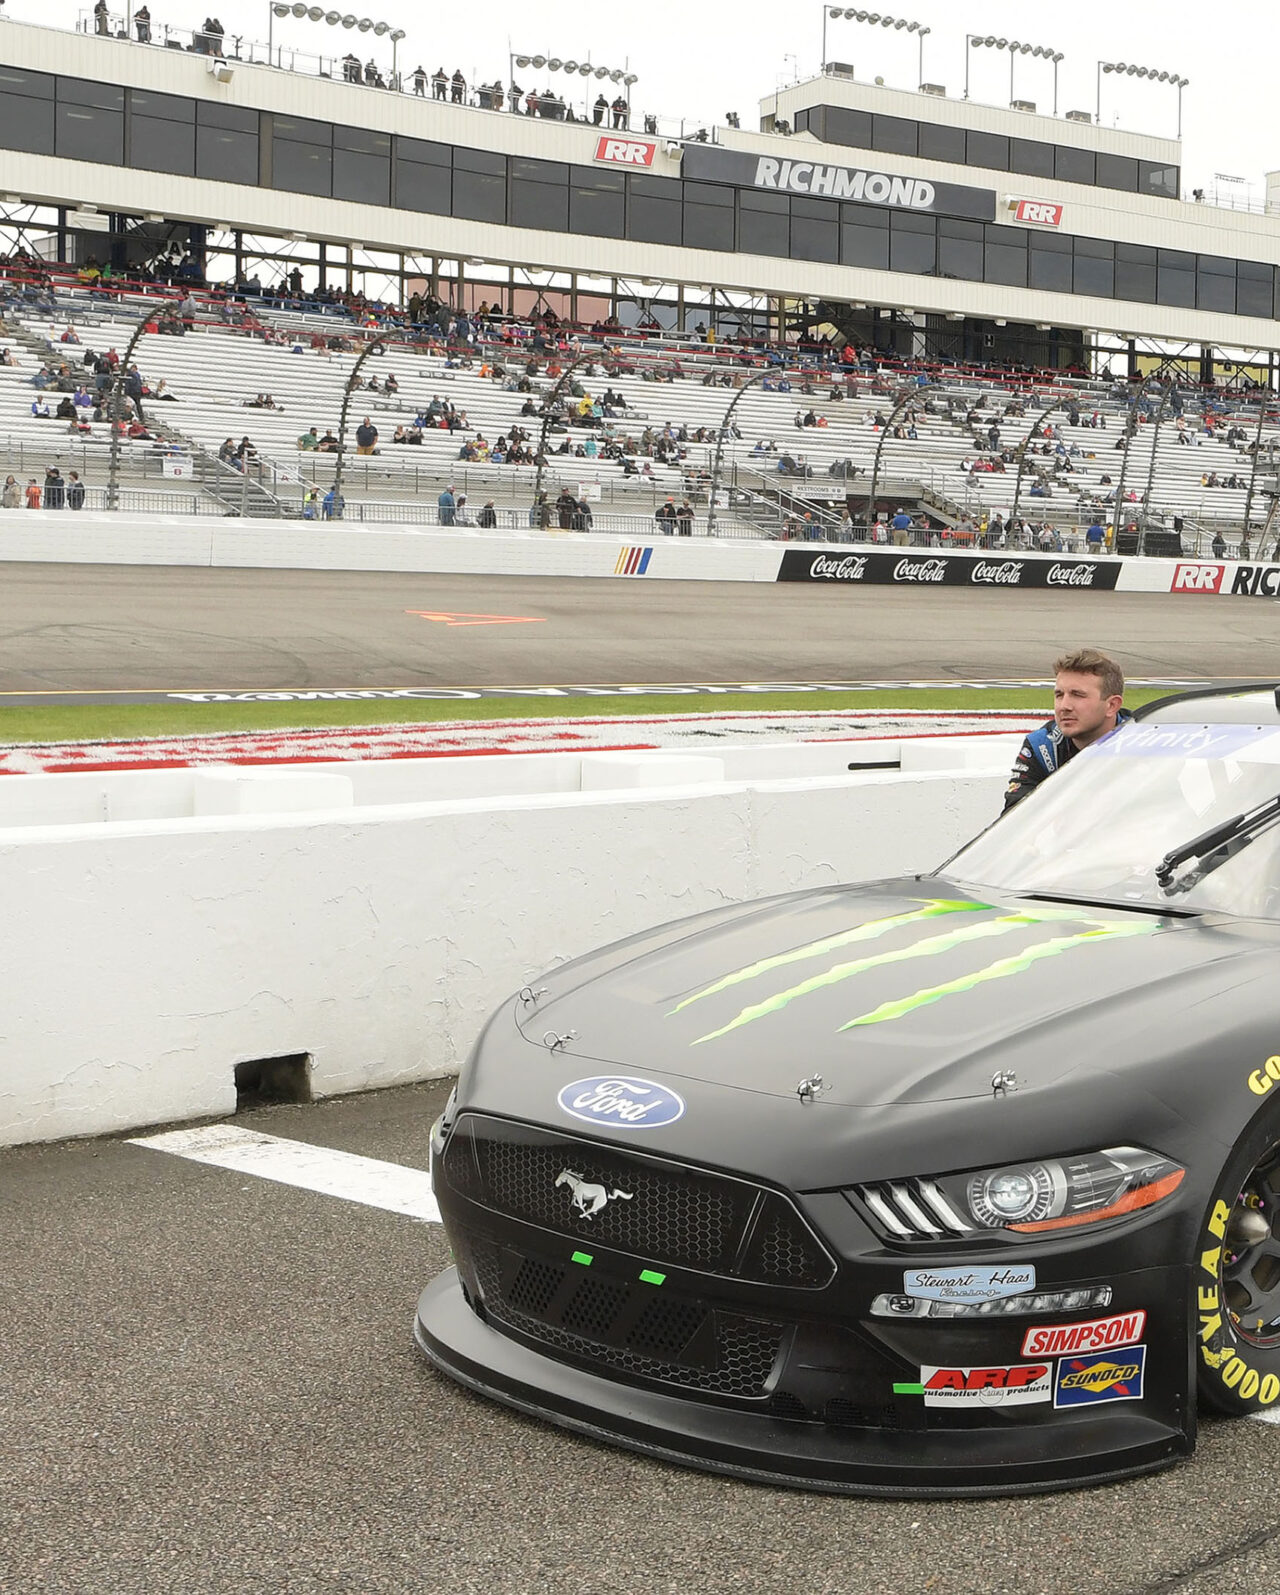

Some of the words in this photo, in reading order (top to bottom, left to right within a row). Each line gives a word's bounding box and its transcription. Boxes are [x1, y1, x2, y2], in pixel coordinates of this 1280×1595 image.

[603, 141, 648, 166] RR
[754, 156, 935, 209] RICHMOND
[1022, 203, 1056, 225] RR
[809, 554, 869, 580] Coca-Cola
[893, 557, 949, 582] Coca-Cola
[971, 560, 1025, 584] Coca-Cola
[1046, 563, 1098, 586] Coca-Cola
[1175, 566, 1222, 590] RR
[1112, 727, 1231, 758] xfinity
[572, 1079, 663, 1122] Ford
[908, 1273, 976, 1287] Stewart
[989, 1270, 1031, 1286] Haas
[939, 1287, 1000, 1298] Racing
[1029, 1316, 1138, 1353] SIMPSON
[923, 1365, 1049, 1390] ARP
[1061, 1364, 1139, 1387] SUNOCO
[923, 1389, 978, 1398] automotive
[1007, 1384, 1050, 1396] products
